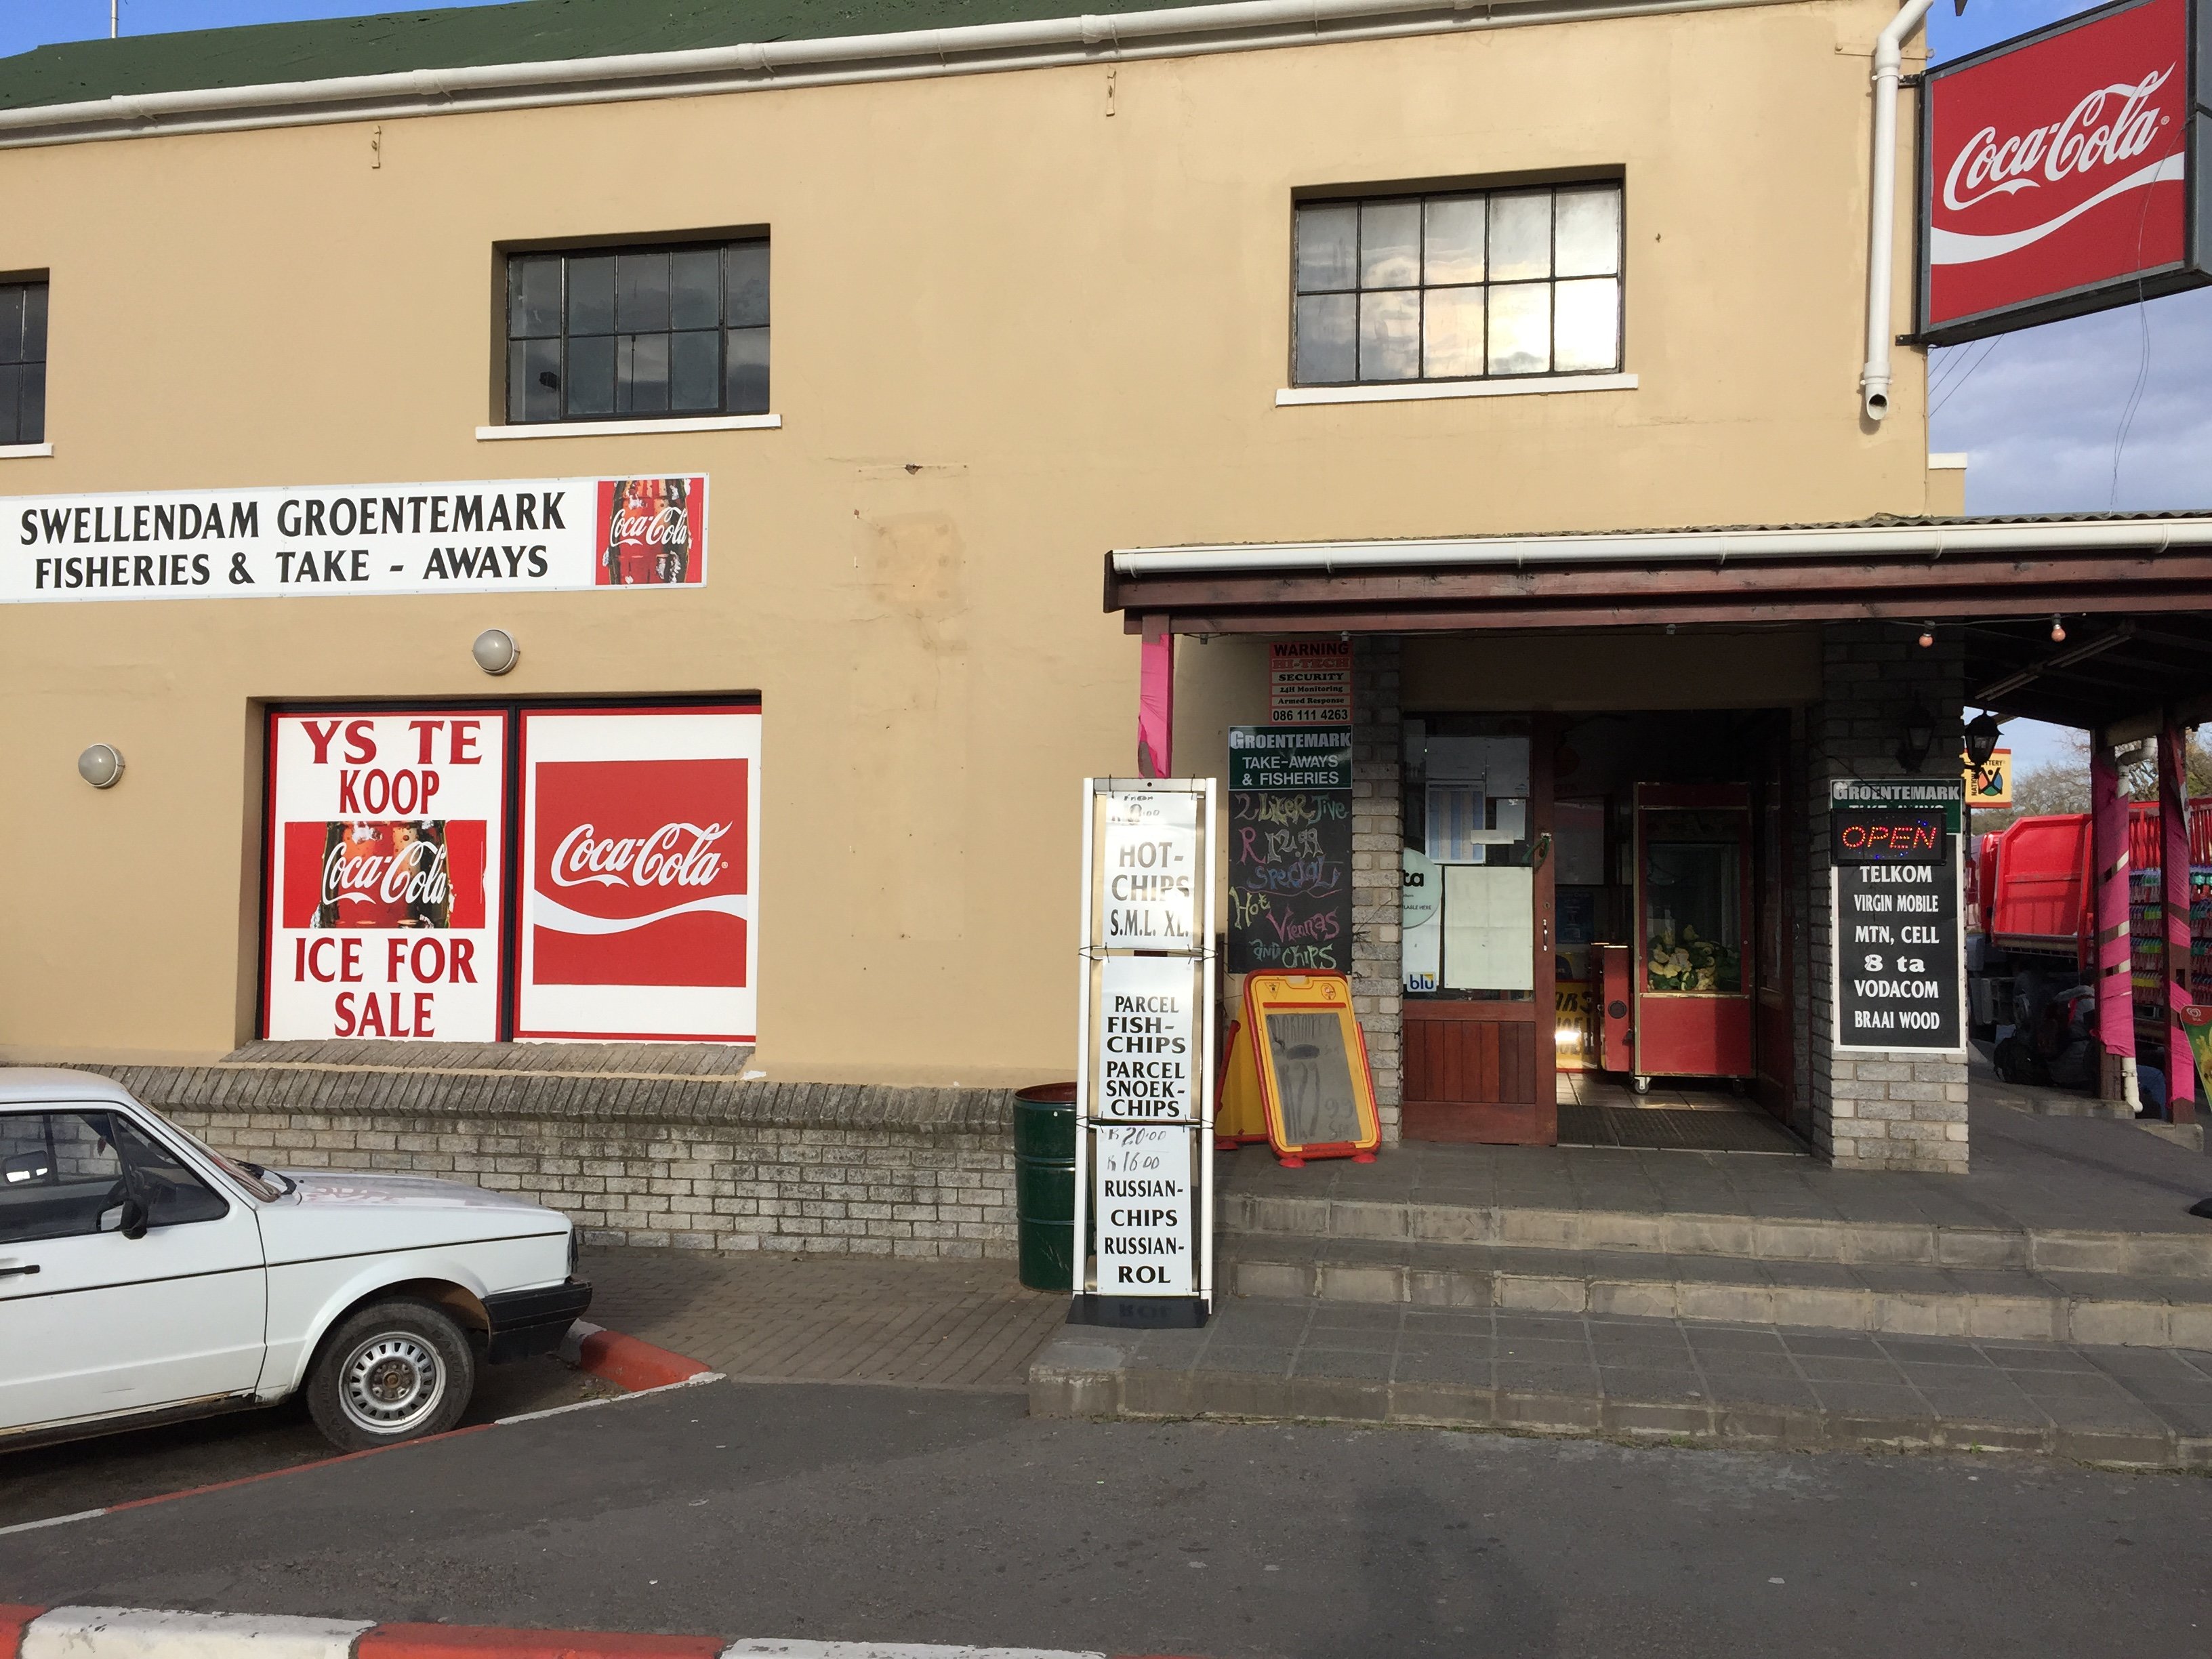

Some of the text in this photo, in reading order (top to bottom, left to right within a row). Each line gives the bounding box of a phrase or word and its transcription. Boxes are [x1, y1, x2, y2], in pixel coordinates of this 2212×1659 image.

[1943, 60, 2176, 211] Coca-Cola
[20, 492, 567, 545] SWELLENDAM GROENTEMARK
[610, 506, 687, 547] Coca-Cola
[35, 550, 211, 589] FISHERIES
[228, 552, 255, 584] &
[275, 550, 370, 583] TAKE
[422, 545, 548, 579] AWAYS
[1274, 642, 1349, 656] WARNING
[1279, 673, 1344, 681] SECURITY
[1273, 710, 1348, 720] 086 111 4263
[300, 720, 483, 764] YS TE
[1230, 731, 1351, 749] GROENTEMARK
[1242, 755, 1338, 769] TAKE-AWAYS
[1242, 771, 1339, 785] & FISHERIES
[339, 769, 441, 815] KOOP
[1833, 782, 1960, 800] GROENTEMARK
[1234, 793, 1259, 821] 2
[1236, 826, 1324, 865] R 12.99
[1841, 826, 1936, 848] OPEN
[551, 821, 733, 888] Coca-Cola
[322, 840, 447, 906] Coca-Cola
[1860, 865, 1932, 883] TELKOM
[1111, 874, 1189, 901] CHIPS
[1853, 895, 1938, 912] VIRGIN MOBILE
[1901, 926, 1940, 943] CELL
[294, 938, 478, 983] ICE FOR
[1864, 954, 1925, 972] 8 ta
[1410, 974, 1433, 989] blu
[1854, 980, 1939, 998] VODACOM
[1115, 996, 1179, 1013] PARCEL
[334, 992, 434, 1038] SALE
[1855, 1011, 1940, 1029] BRAAI WOOD
[1107, 1017, 1174, 1033] FISH-
[1107, 1036, 1185, 1054] CHIPS
[1107, 1061, 1185, 1078] PARCEL
[1106, 1080, 1185, 1098] SNOEK-
[1111, 1100, 1180, 1117] CHIPS
[1105, 1181, 1183, 1197] RUSSIAN-
[1111, 1210, 1178, 1227] CHIPS
[1105, 1237, 1185, 1254] RUSSIAN-
[1118, 1266, 1171, 1283] ROL
